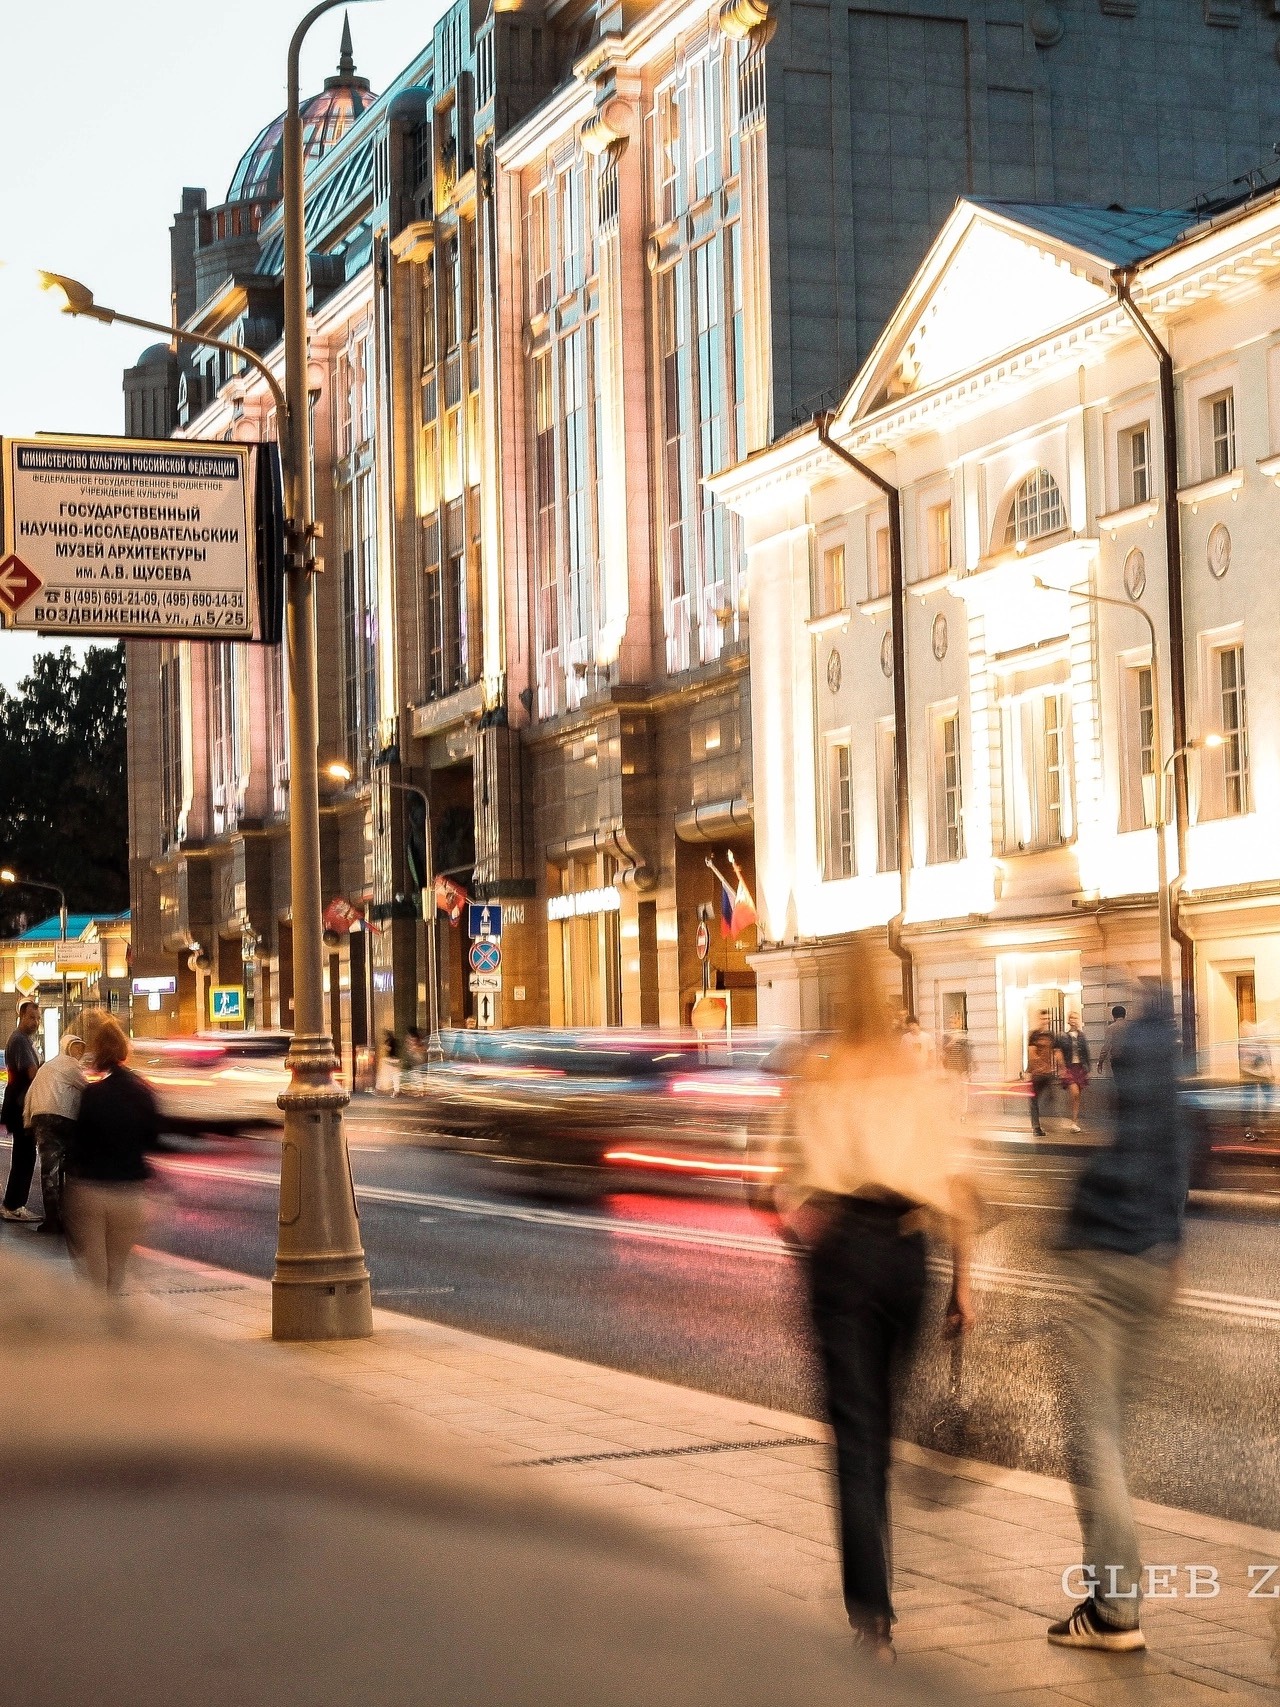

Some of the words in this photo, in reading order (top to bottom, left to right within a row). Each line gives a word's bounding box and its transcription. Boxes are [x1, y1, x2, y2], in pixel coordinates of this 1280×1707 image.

[22, 451, 87, 468] МИНИСТЕРСТВО
[89, 454, 130, 471] КУЛЬТУРЫ
[132, 456, 186, 474] РОССИЙСКОЙ
[188, 459, 235, 477] ФЕДЕРАЦИИ
[32, 474, 92, 485] ФЕДЕРАЛЬНОЕ
[94, 477, 170, 488] ГОСУДАРСТВЕННОЕ
[172, 481, 222, 491] БЮДЖЕТНОЕ
[80, 487, 134, 497] УЧРЕЖДЕНИЕ
[136, 489, 178, 499] КУЛЬТУРЫ
[59, 503, 200, 522] ГОСУДАРСТВЕННЫЙ
[55, 541, 104, 558] МУЗЕЙ
[107, 545, 206, 561] АРХИТЕКТУРЫ
[75, 567, 97, 578] им.
[100, 564, 129, 580] А.В.
[132, 566, 192, 582] ЩУСЕВА
[64, 590, 71, 604] 8
[73, 590, 101, 606] (495)
[103, 591, 160, 608] 691-21-09,
[162, 592, 189, 609] (495)
[192, 594, 244, 608] 690-14-31
[34, 607, 161, 624] ВОЗДВИЖЕНКА
